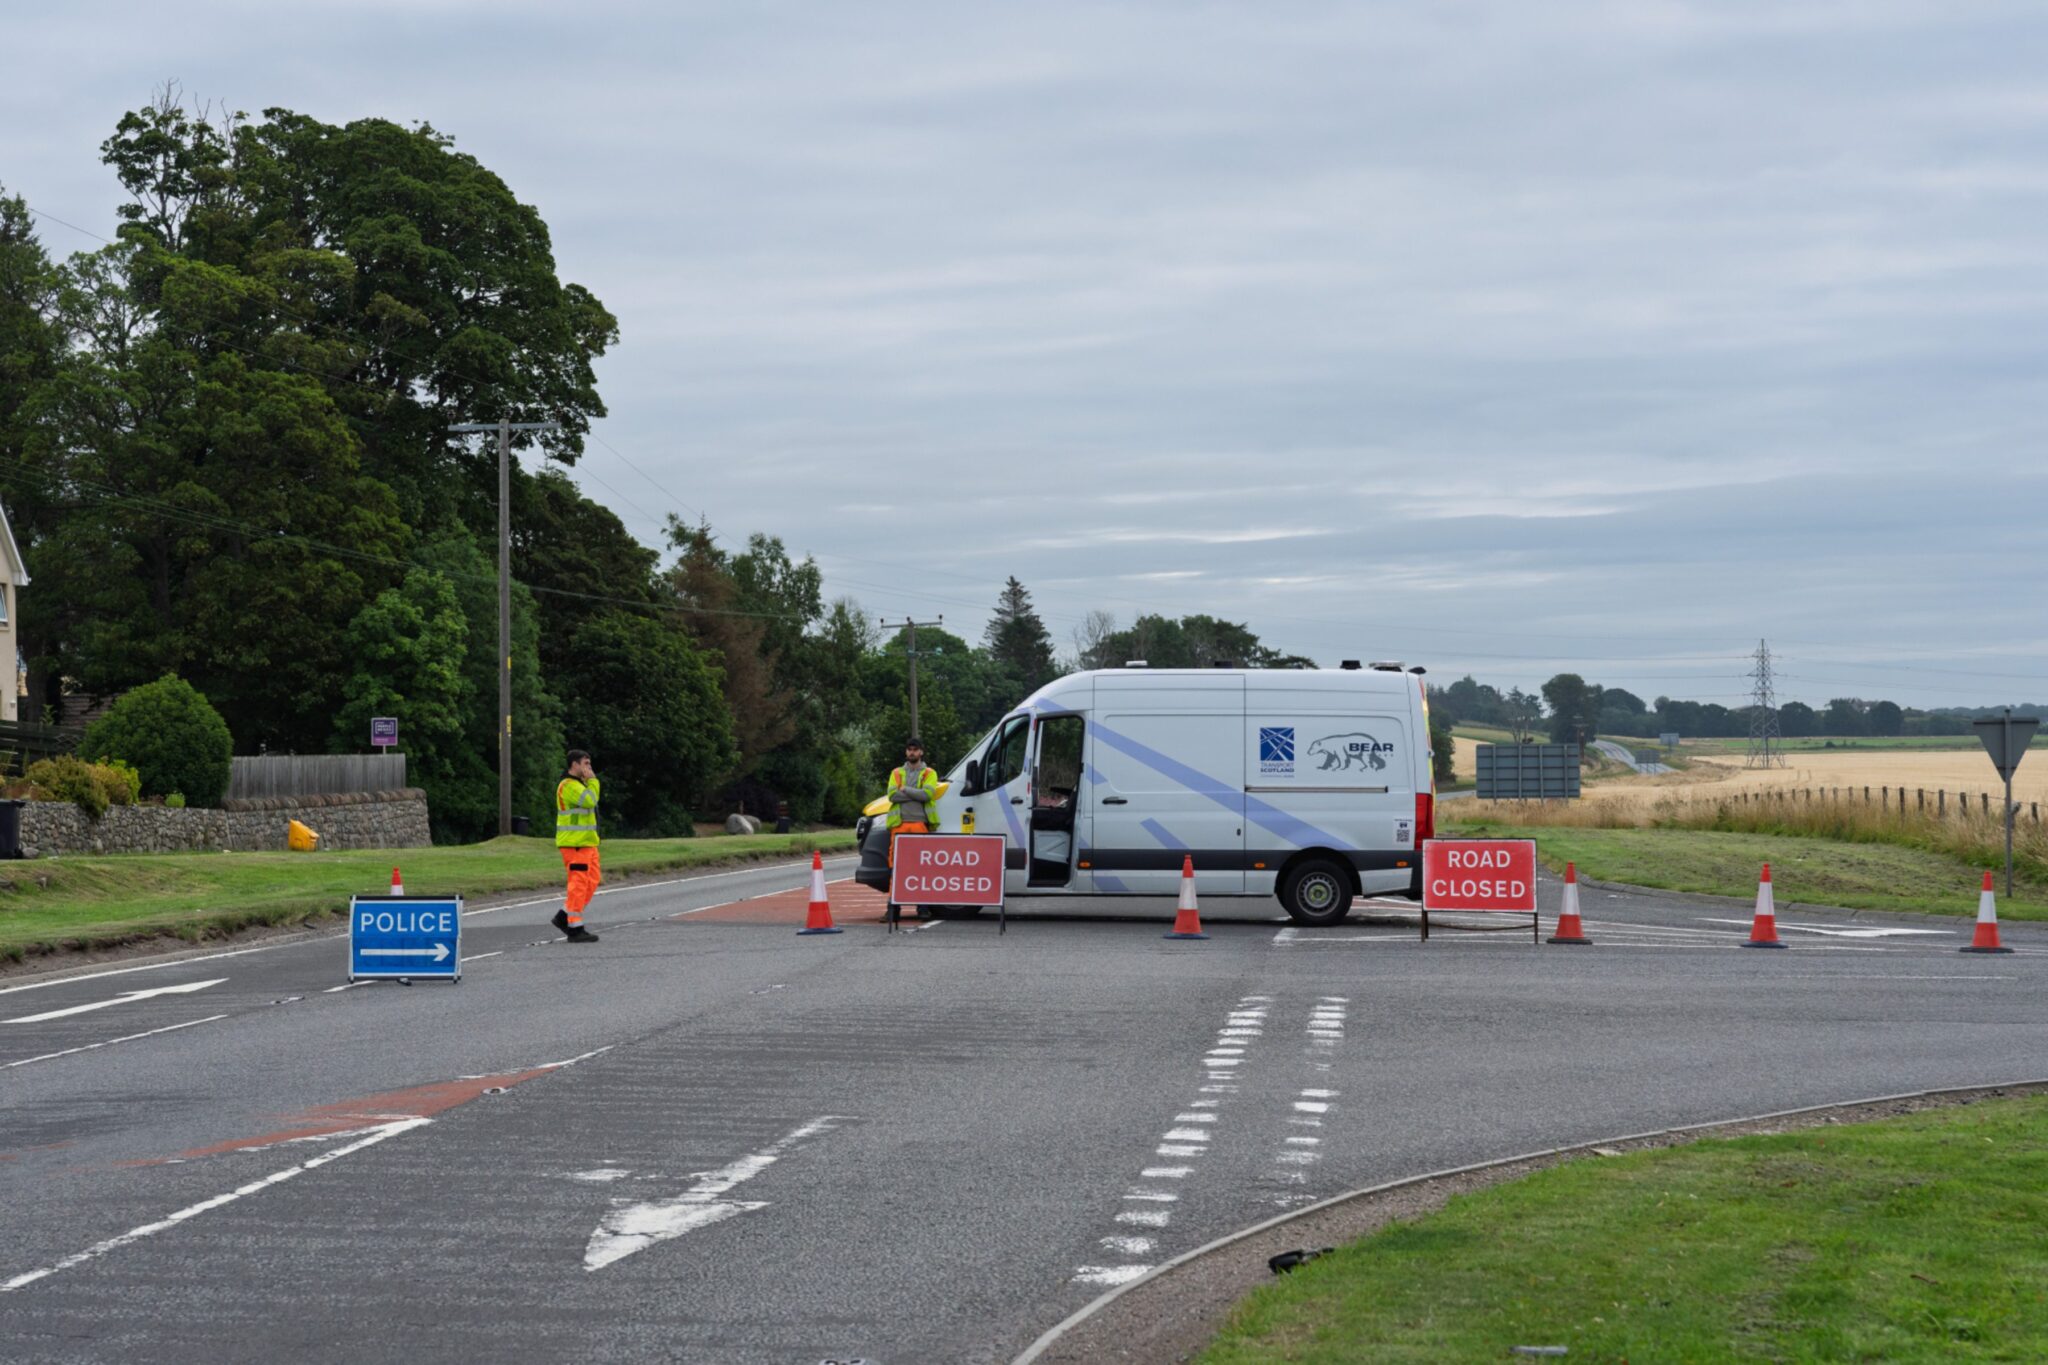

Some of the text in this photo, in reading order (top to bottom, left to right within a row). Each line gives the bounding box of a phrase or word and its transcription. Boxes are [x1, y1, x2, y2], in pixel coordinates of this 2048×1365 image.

[1348, 743, 1394, 752] BEAR
[919, 850, 980, 866] ROAD
[1448, 850, 1511, 868] ROAD
[904, 875, 992, 892] CLOSED
[1432, 879, 1525, 898] CLOSED
[361, 912, 452, 932] POLICE
